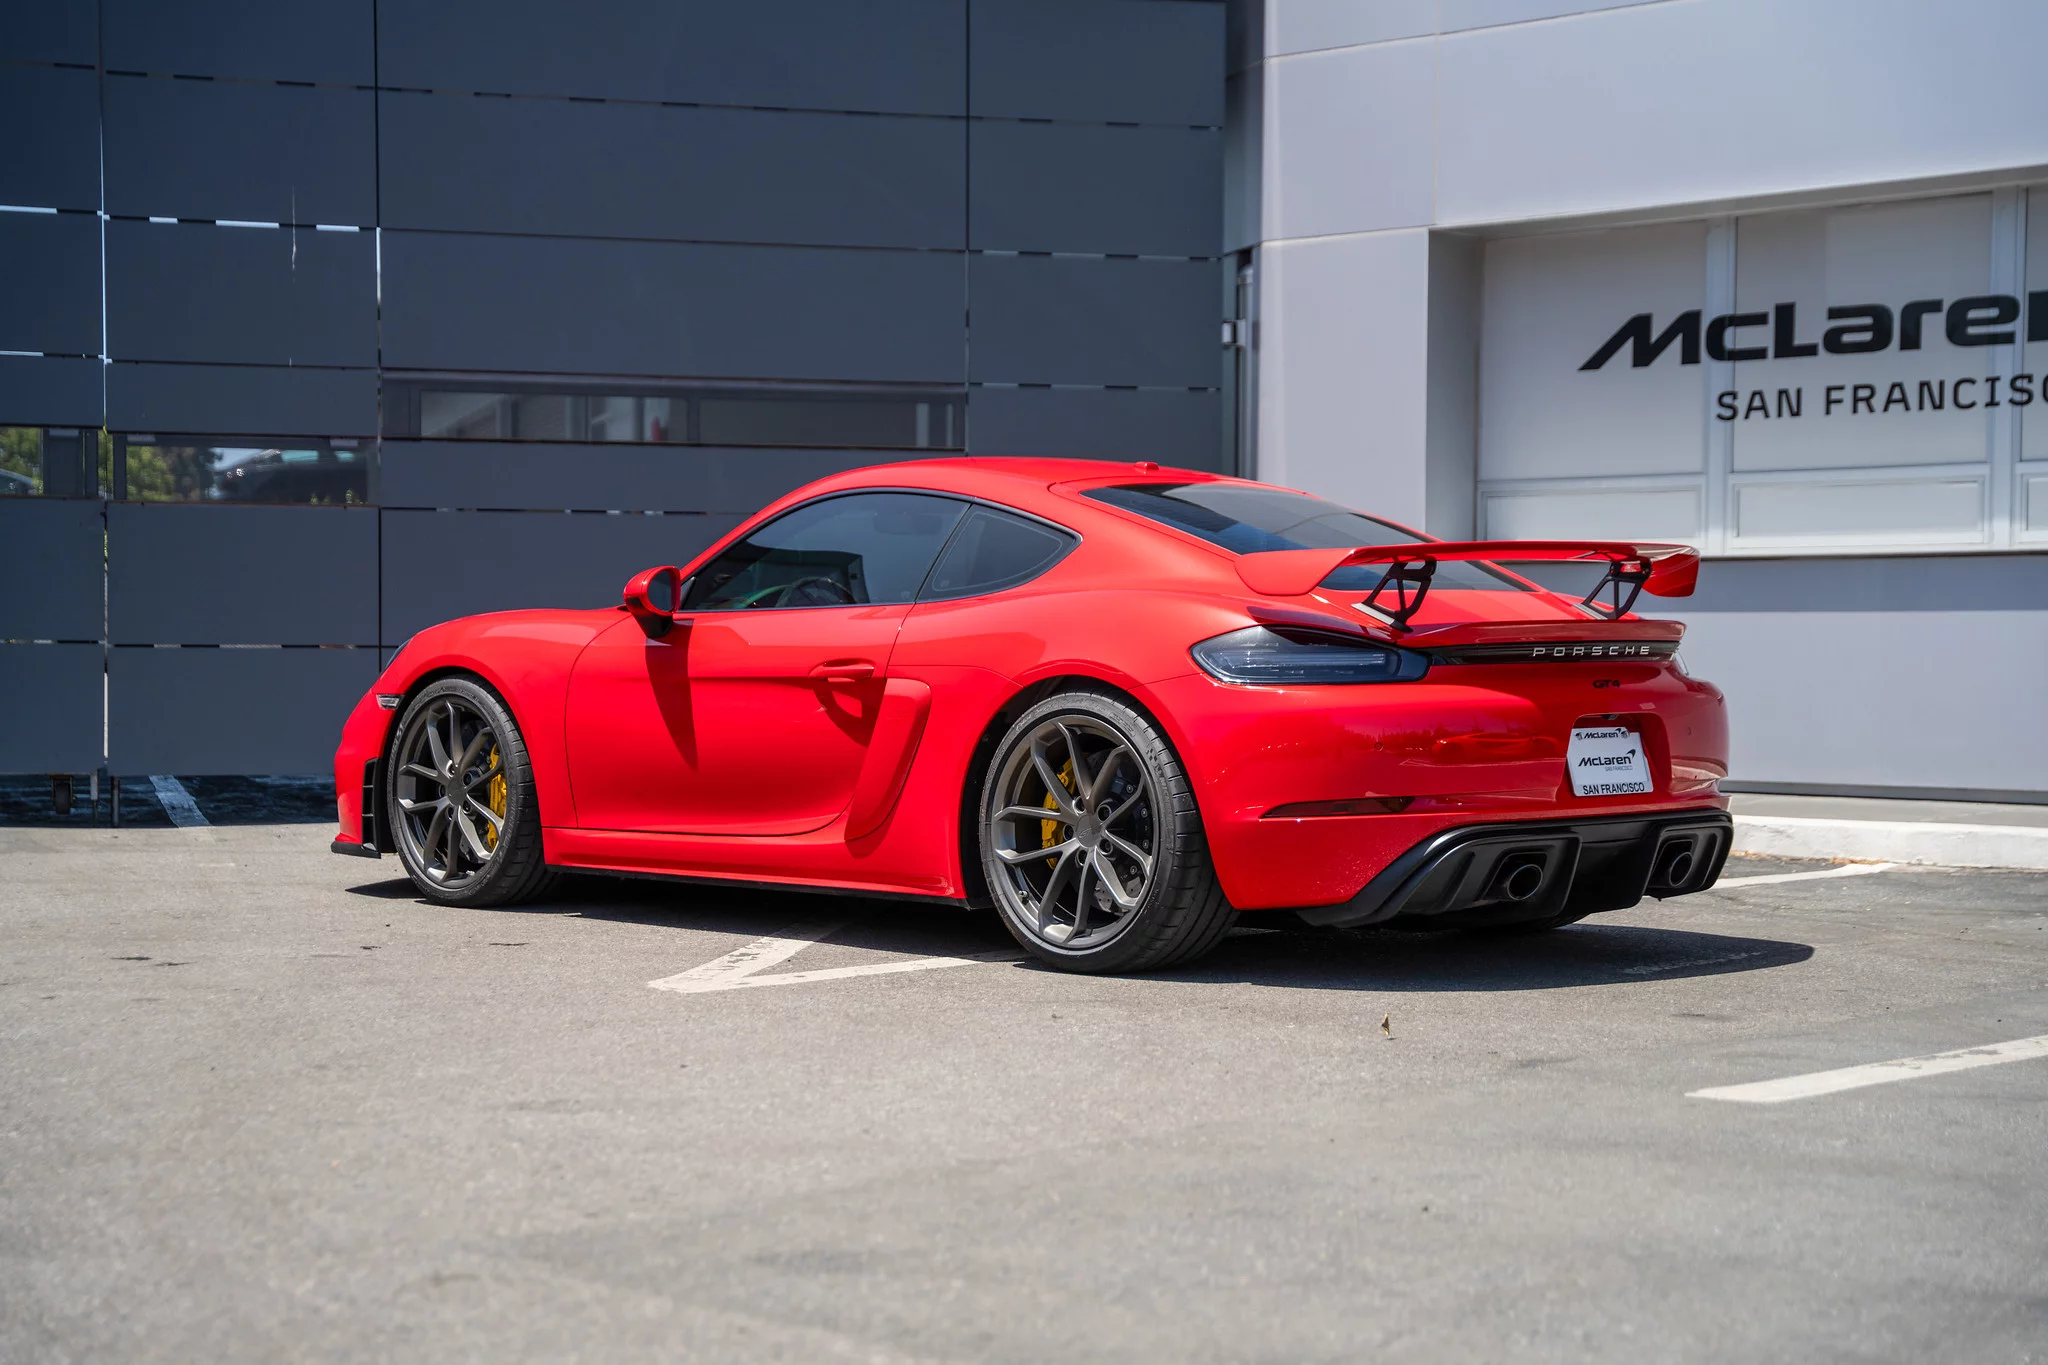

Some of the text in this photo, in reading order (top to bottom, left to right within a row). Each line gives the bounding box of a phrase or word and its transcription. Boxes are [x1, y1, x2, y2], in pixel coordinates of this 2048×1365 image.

[1716, 373, 2048, 421] SAN FRANCIS
[1532, 645, 1650, 657] PORSCHE
[1592, 679, 1621, 689] GT4
[1578, 756, 1632, 767] McLaren
[1583, 782, 1645, 795] SAN FRANCISCO
